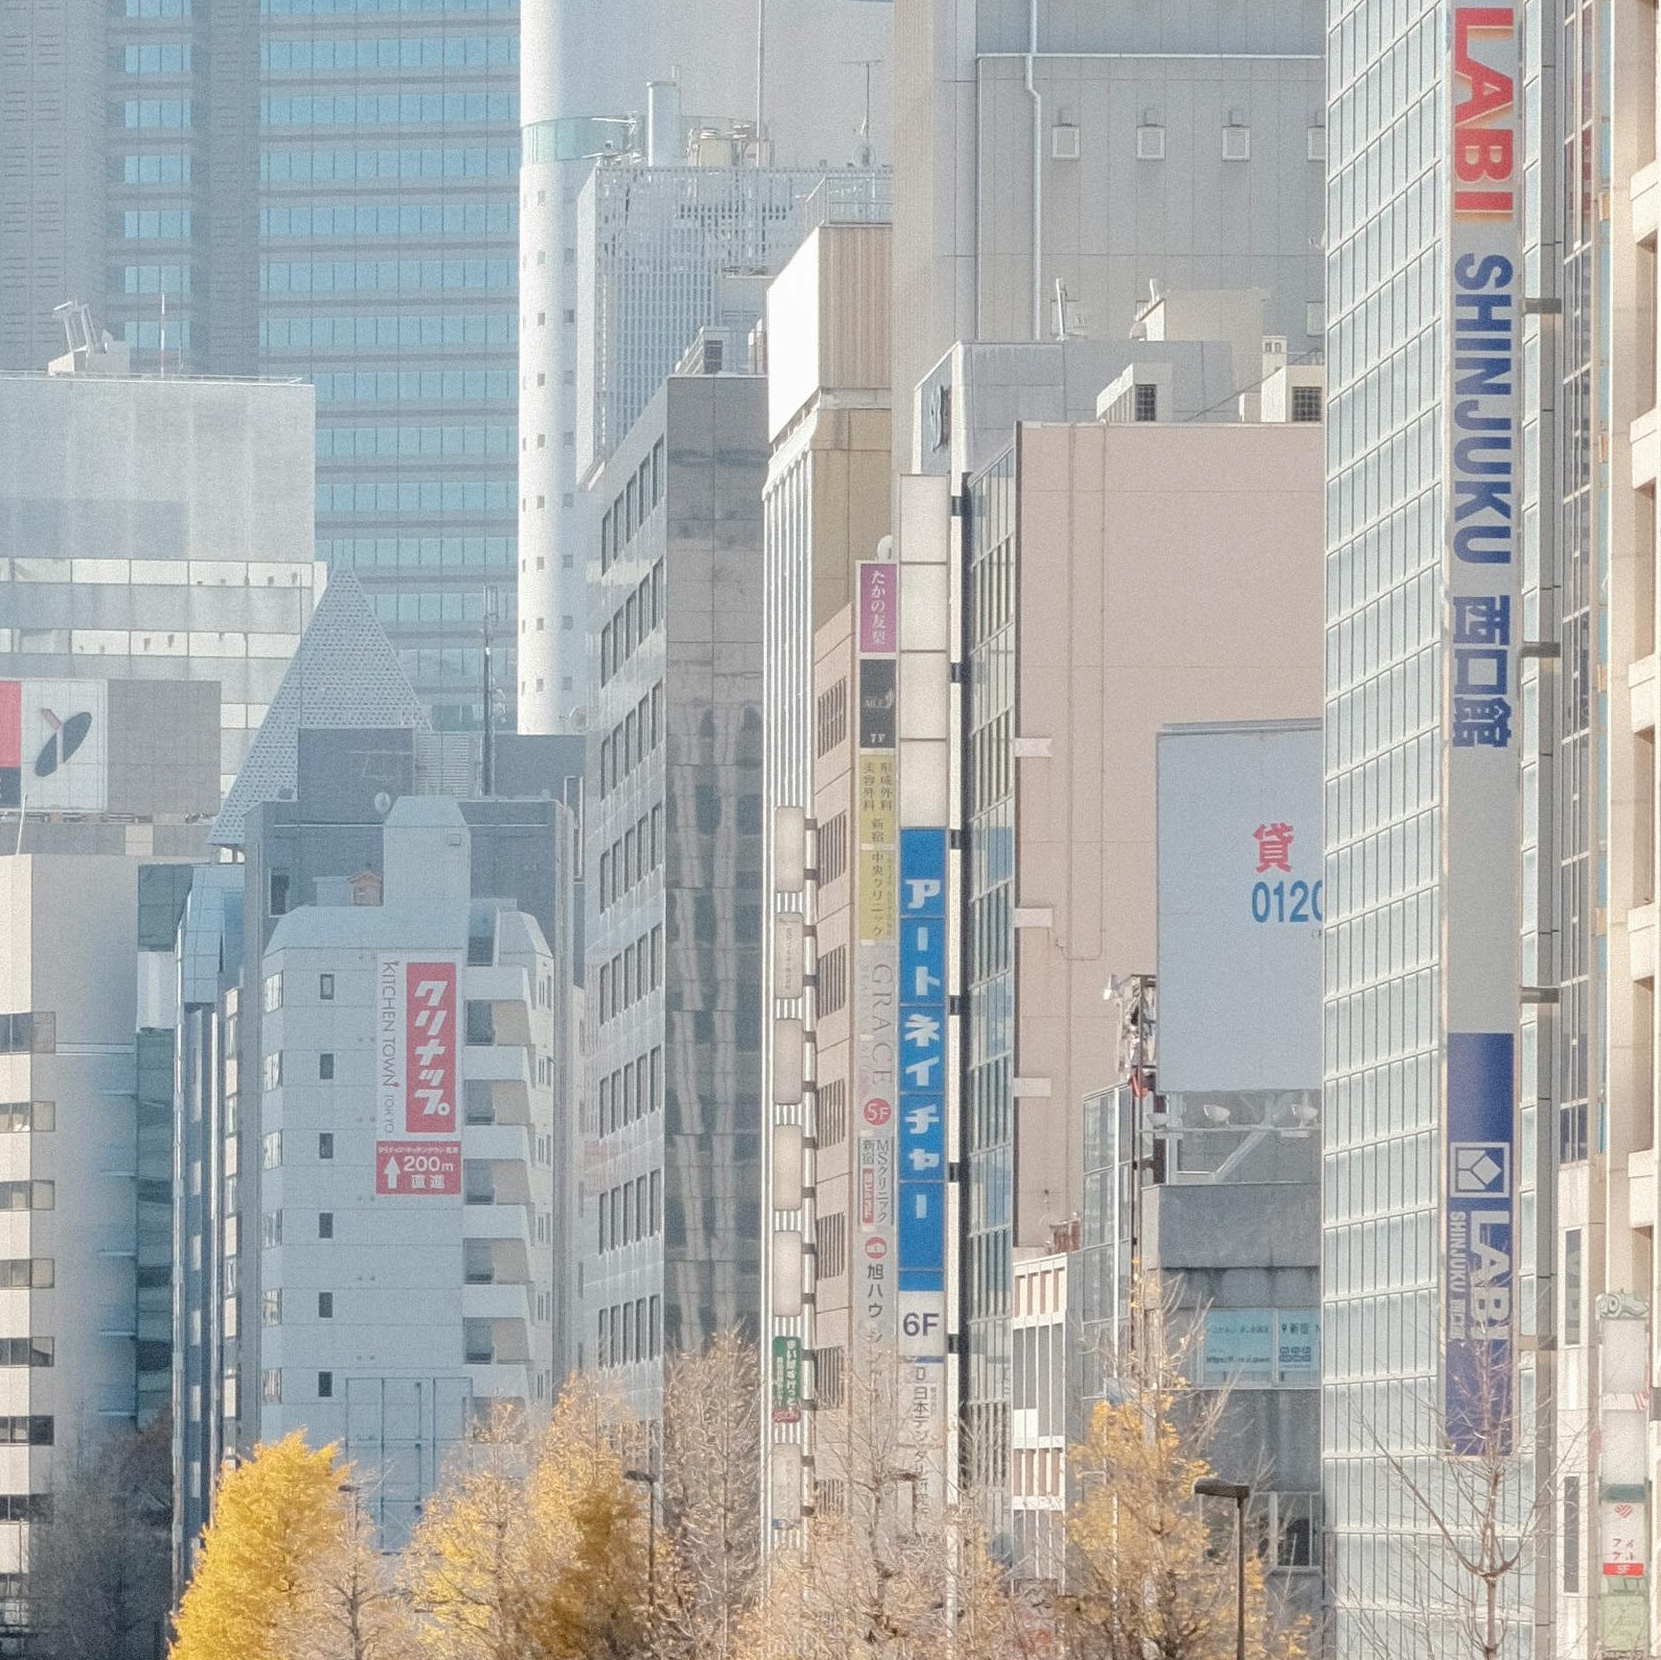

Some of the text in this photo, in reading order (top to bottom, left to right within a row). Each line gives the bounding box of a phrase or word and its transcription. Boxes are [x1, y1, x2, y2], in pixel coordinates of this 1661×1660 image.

[1452, 6, 1514, 748] LABI SHINJUKU 西口館
[870, 569, 887, 645] たかの友梨
[1252, 821, 1295, 874] 貸
[382, 961, 399, 1033] KITCHEN
[872, 964, 893, 1086] GRACE
[382, 1036, 399, 1089] TOWN
[413, 979, 450, 1117] クリナップ
[904, 879, 941, 1219] アートネイチャー
[404, 1155, 454, 1173] 200m
[902, 1312, 940, 1336] 6F
